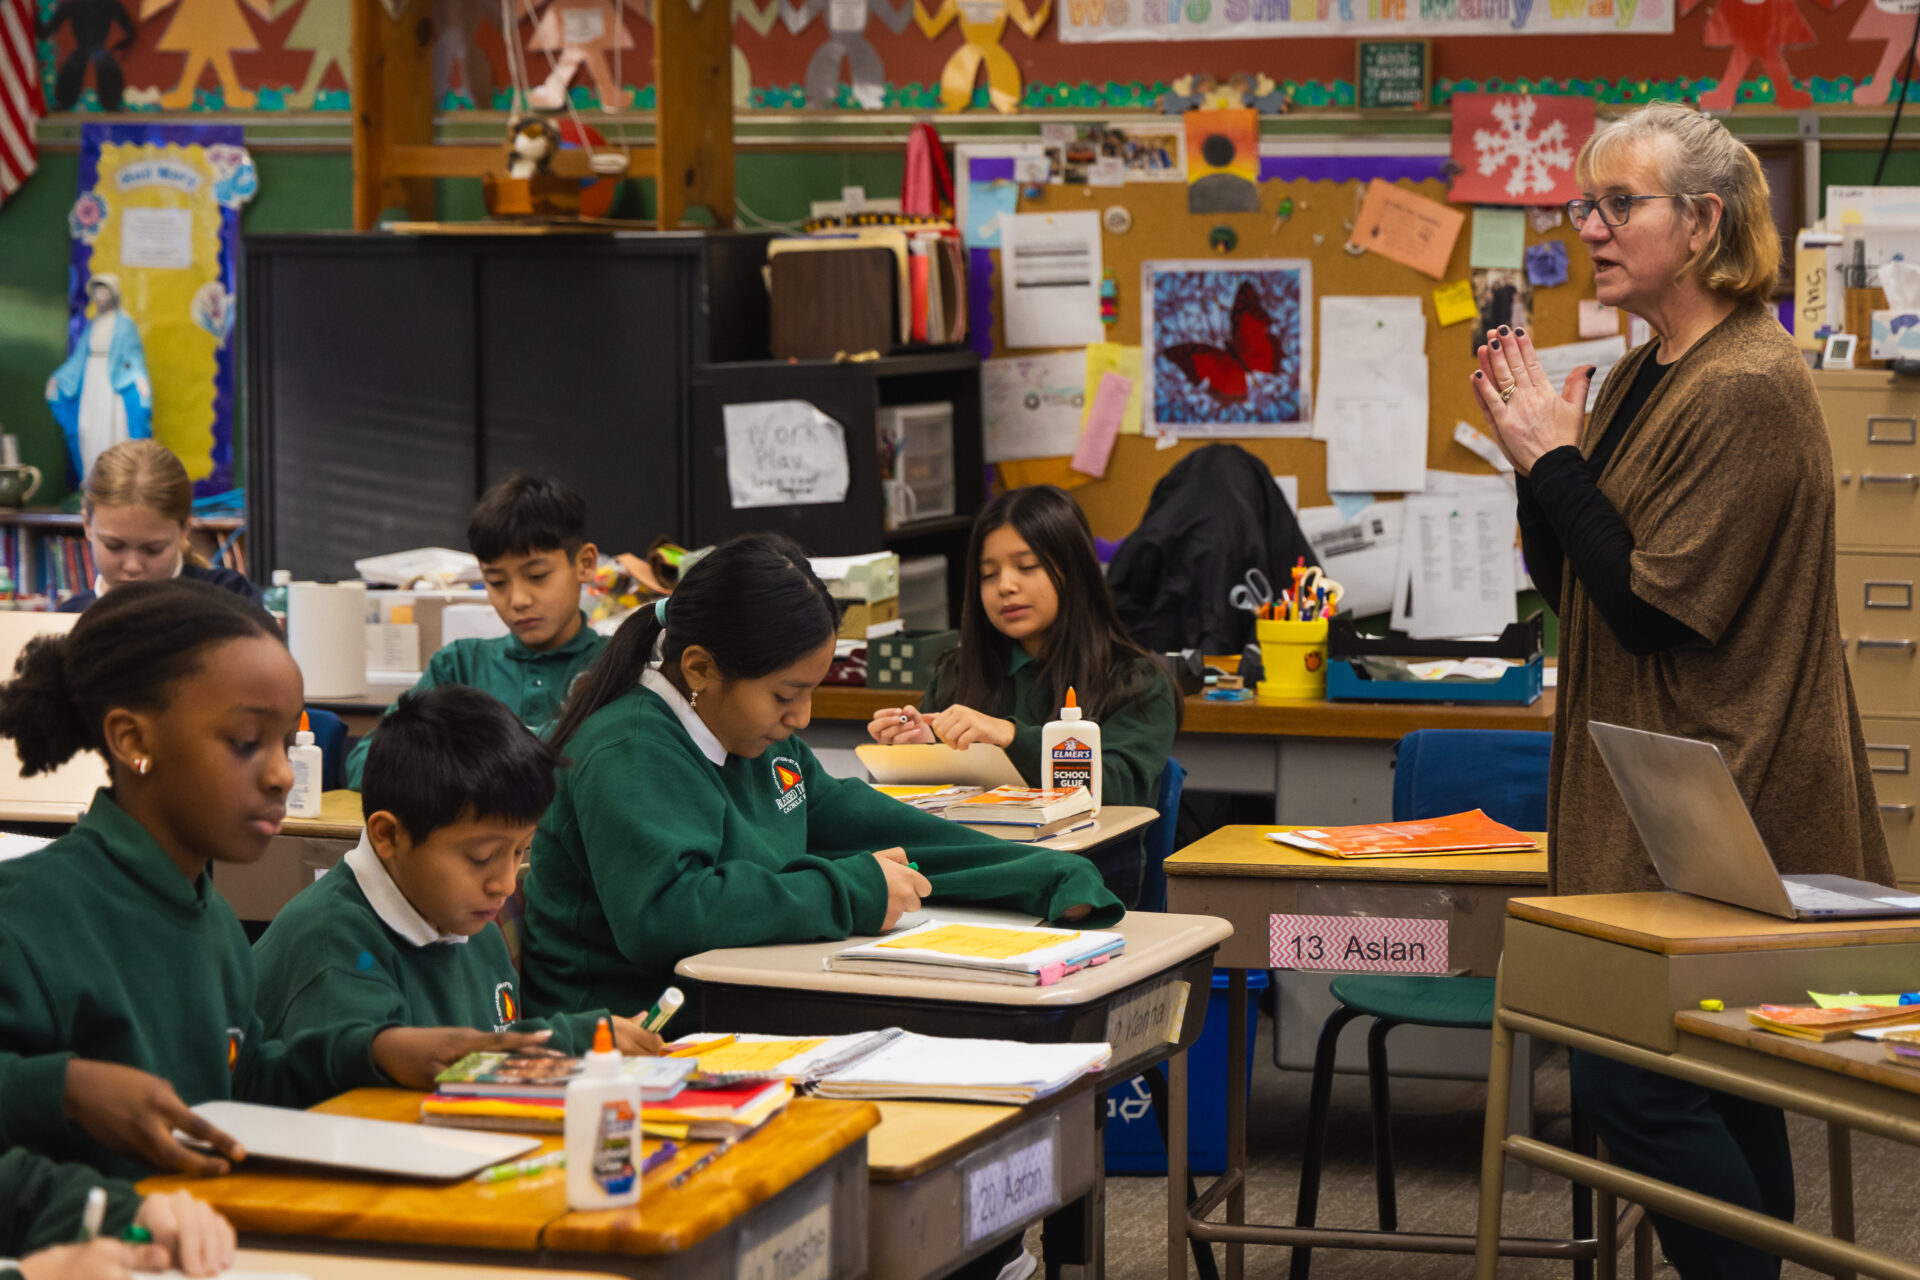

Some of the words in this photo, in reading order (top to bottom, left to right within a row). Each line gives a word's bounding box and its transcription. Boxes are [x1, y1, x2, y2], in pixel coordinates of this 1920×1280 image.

[746, 413, 820, 447] Work
[1053, 750, 1090, 758] ELMER'S
[1054, 770, 1091, 779] SCHOOL
[1060, 779, 1084, 787] GLUE
[1290, 935, 1325, 960] 13
[1344, 935, 1425, 961] Aslan
[981, 1183, 996, 1222] 20
[1002, 1167, 1042, 1213] Aaron
